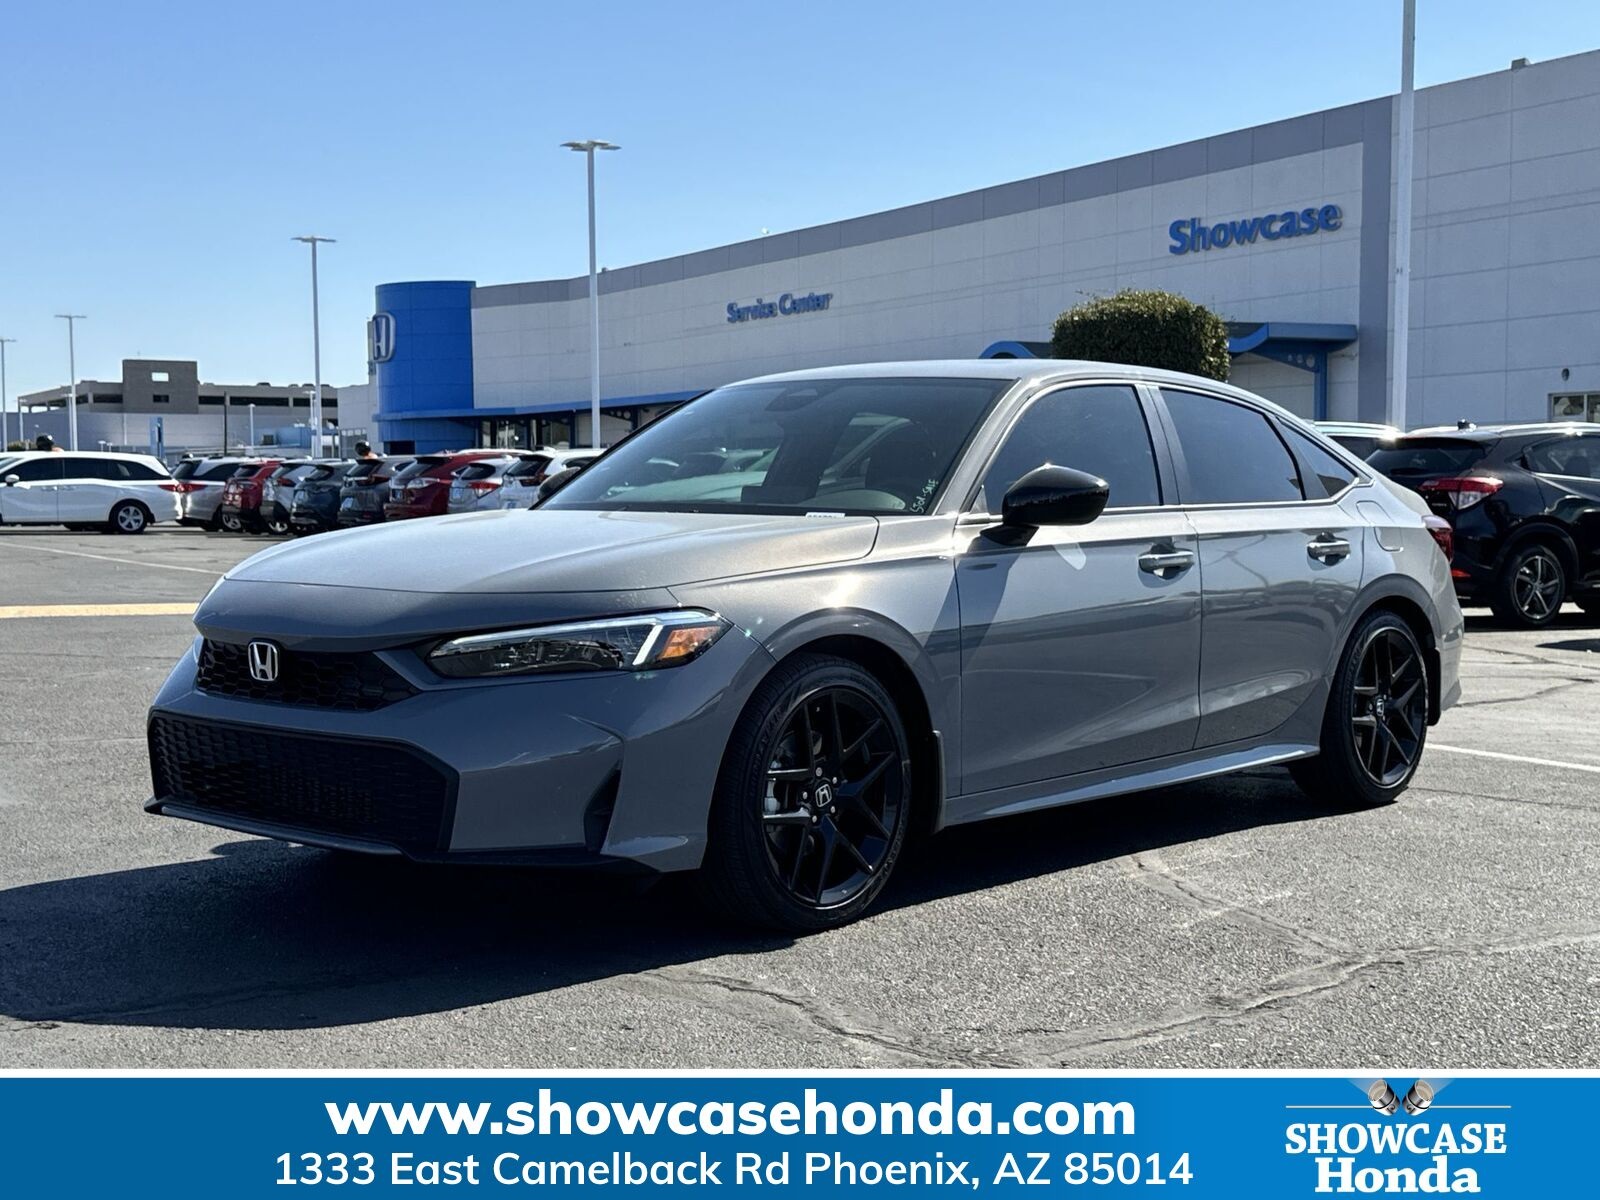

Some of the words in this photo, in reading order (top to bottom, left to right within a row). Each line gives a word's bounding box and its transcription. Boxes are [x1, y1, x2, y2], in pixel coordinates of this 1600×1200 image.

[1168, 204, 1343, 256] Showcase
[727, 298, 778, 324] Service
[779, 292, 834, 316] Center
